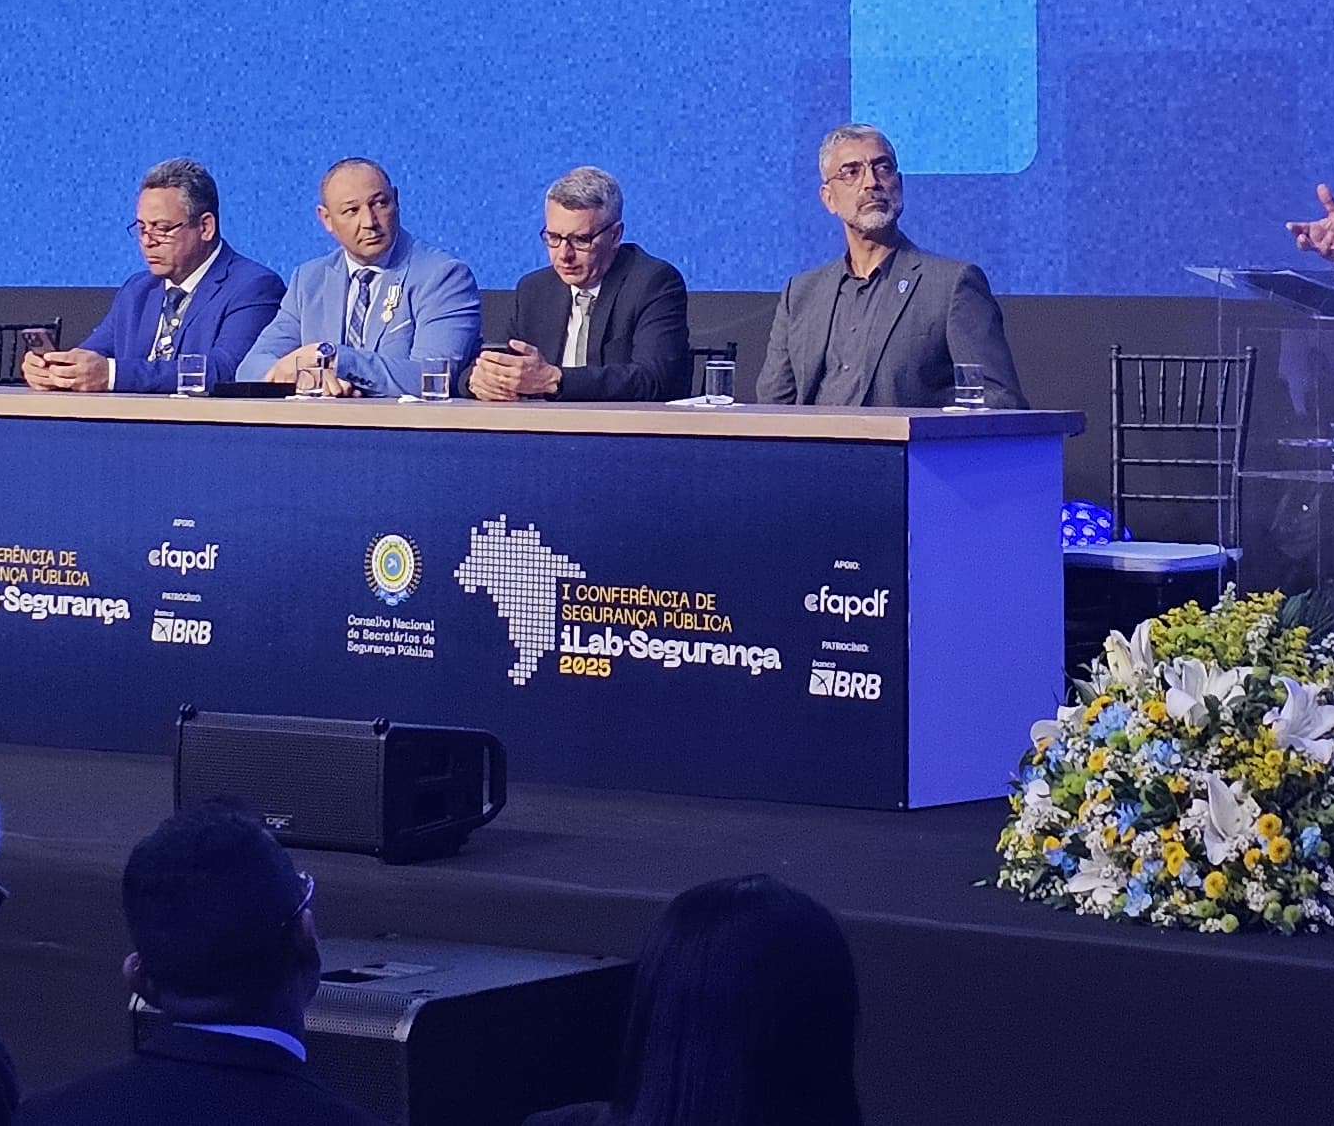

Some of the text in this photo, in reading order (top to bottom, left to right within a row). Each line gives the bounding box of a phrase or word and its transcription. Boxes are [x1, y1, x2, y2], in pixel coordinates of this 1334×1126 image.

[59, 551, 76, 566] DE
[33, 566, 89, 586] PÚBLICA
[562, 584, 715, 610] I CONFERÊNCIA DE
[348, 614, 434, 630] Conselho Nacional
[562, 605, 732, 632] SEGURANÇA PÚBLICA
[173, 619, 211, 644] BRB
[347, 628, 434, 644] de Secretários de
[347, 641, 433, 657] Segurança Pública
[560, 625, 780, 675] iLab-Segurança
[560, 656, 610, 676] 2025
[834, 671, 881, 699] BRB
